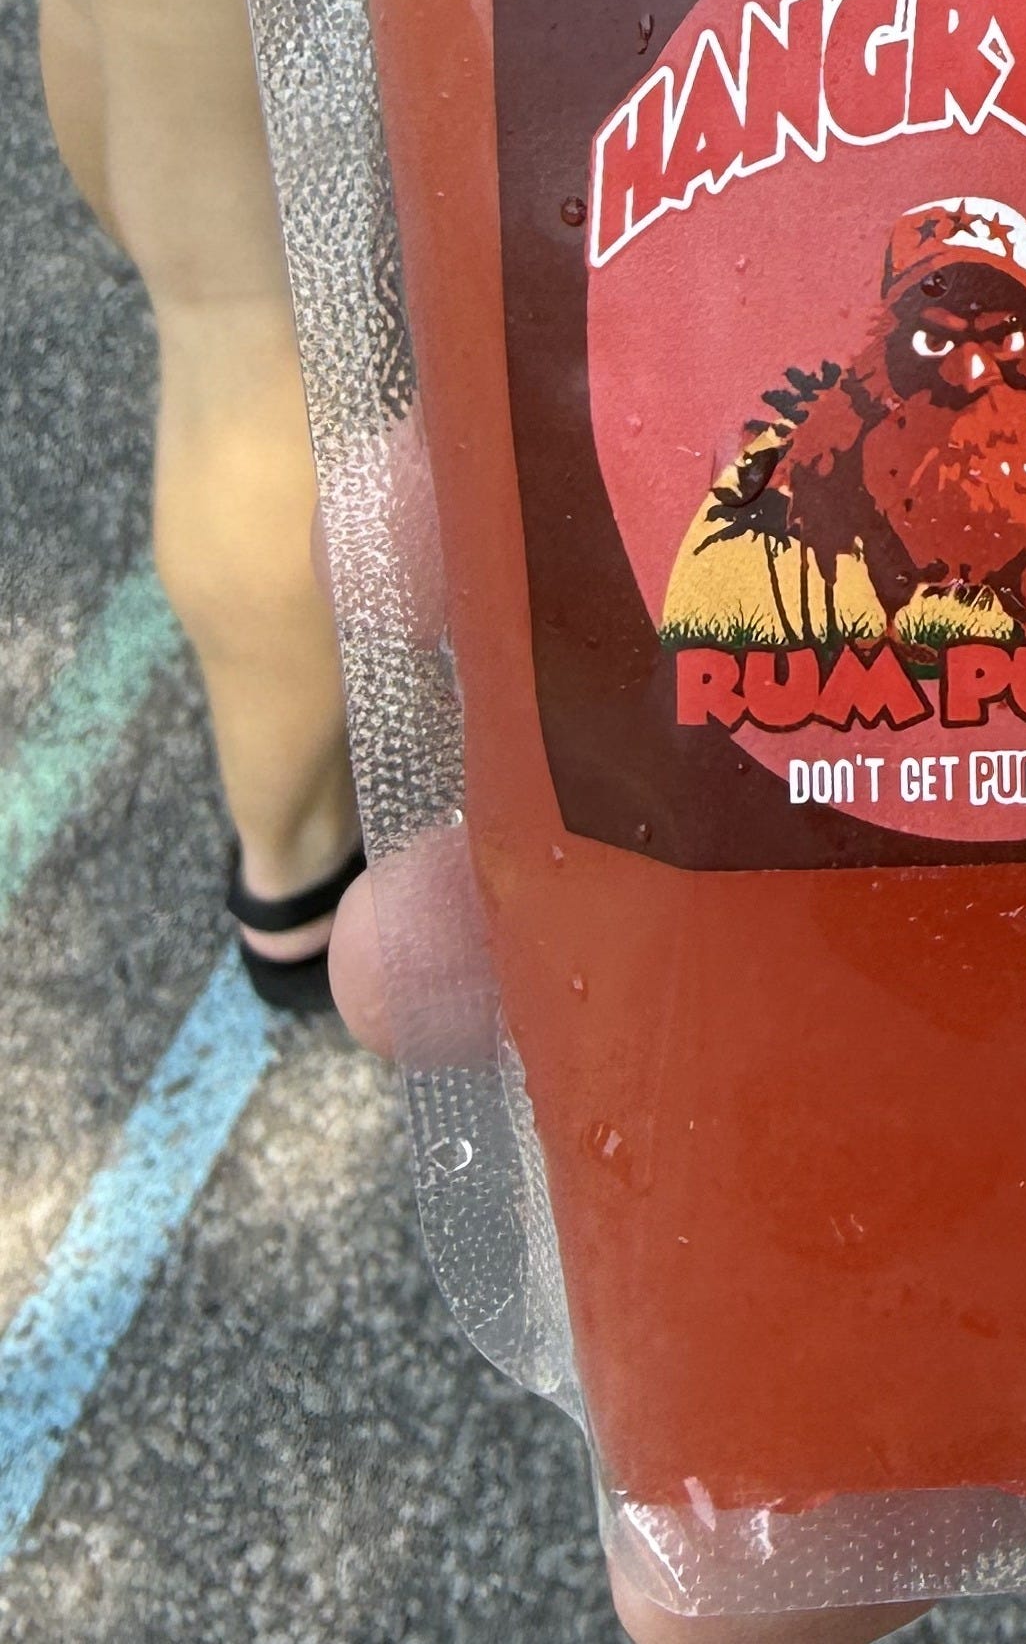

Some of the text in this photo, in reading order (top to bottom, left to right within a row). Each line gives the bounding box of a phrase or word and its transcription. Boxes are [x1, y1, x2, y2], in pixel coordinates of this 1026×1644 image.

[675, 644, 926, 729] RUM
[788, 753, 884, 805] DON'T
[899, 755, 959, 802] GET
